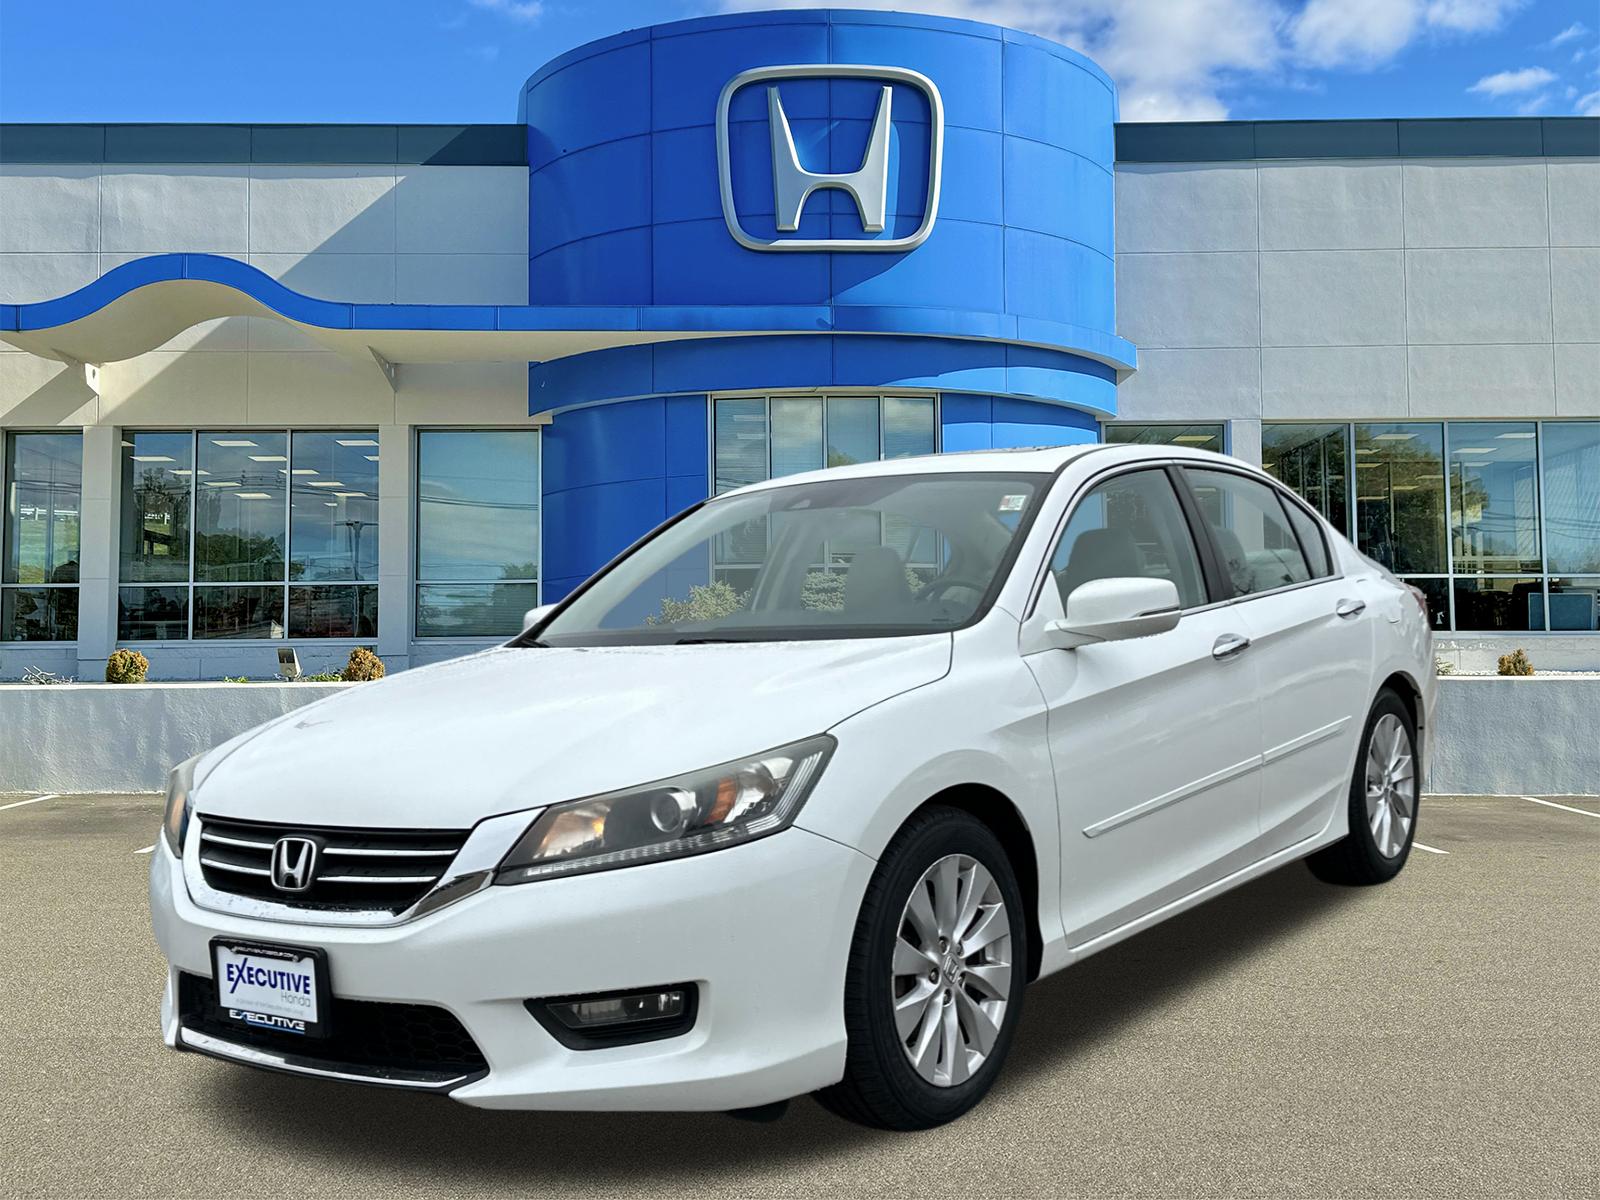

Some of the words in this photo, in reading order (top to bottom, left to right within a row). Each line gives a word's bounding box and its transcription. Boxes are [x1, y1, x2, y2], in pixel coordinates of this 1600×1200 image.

[226, 957, 311, 995] EXECUTIVE
[281, 992, 311, 1008] Honda
[229, 1009, 305, 1030] EXECUTIVE
